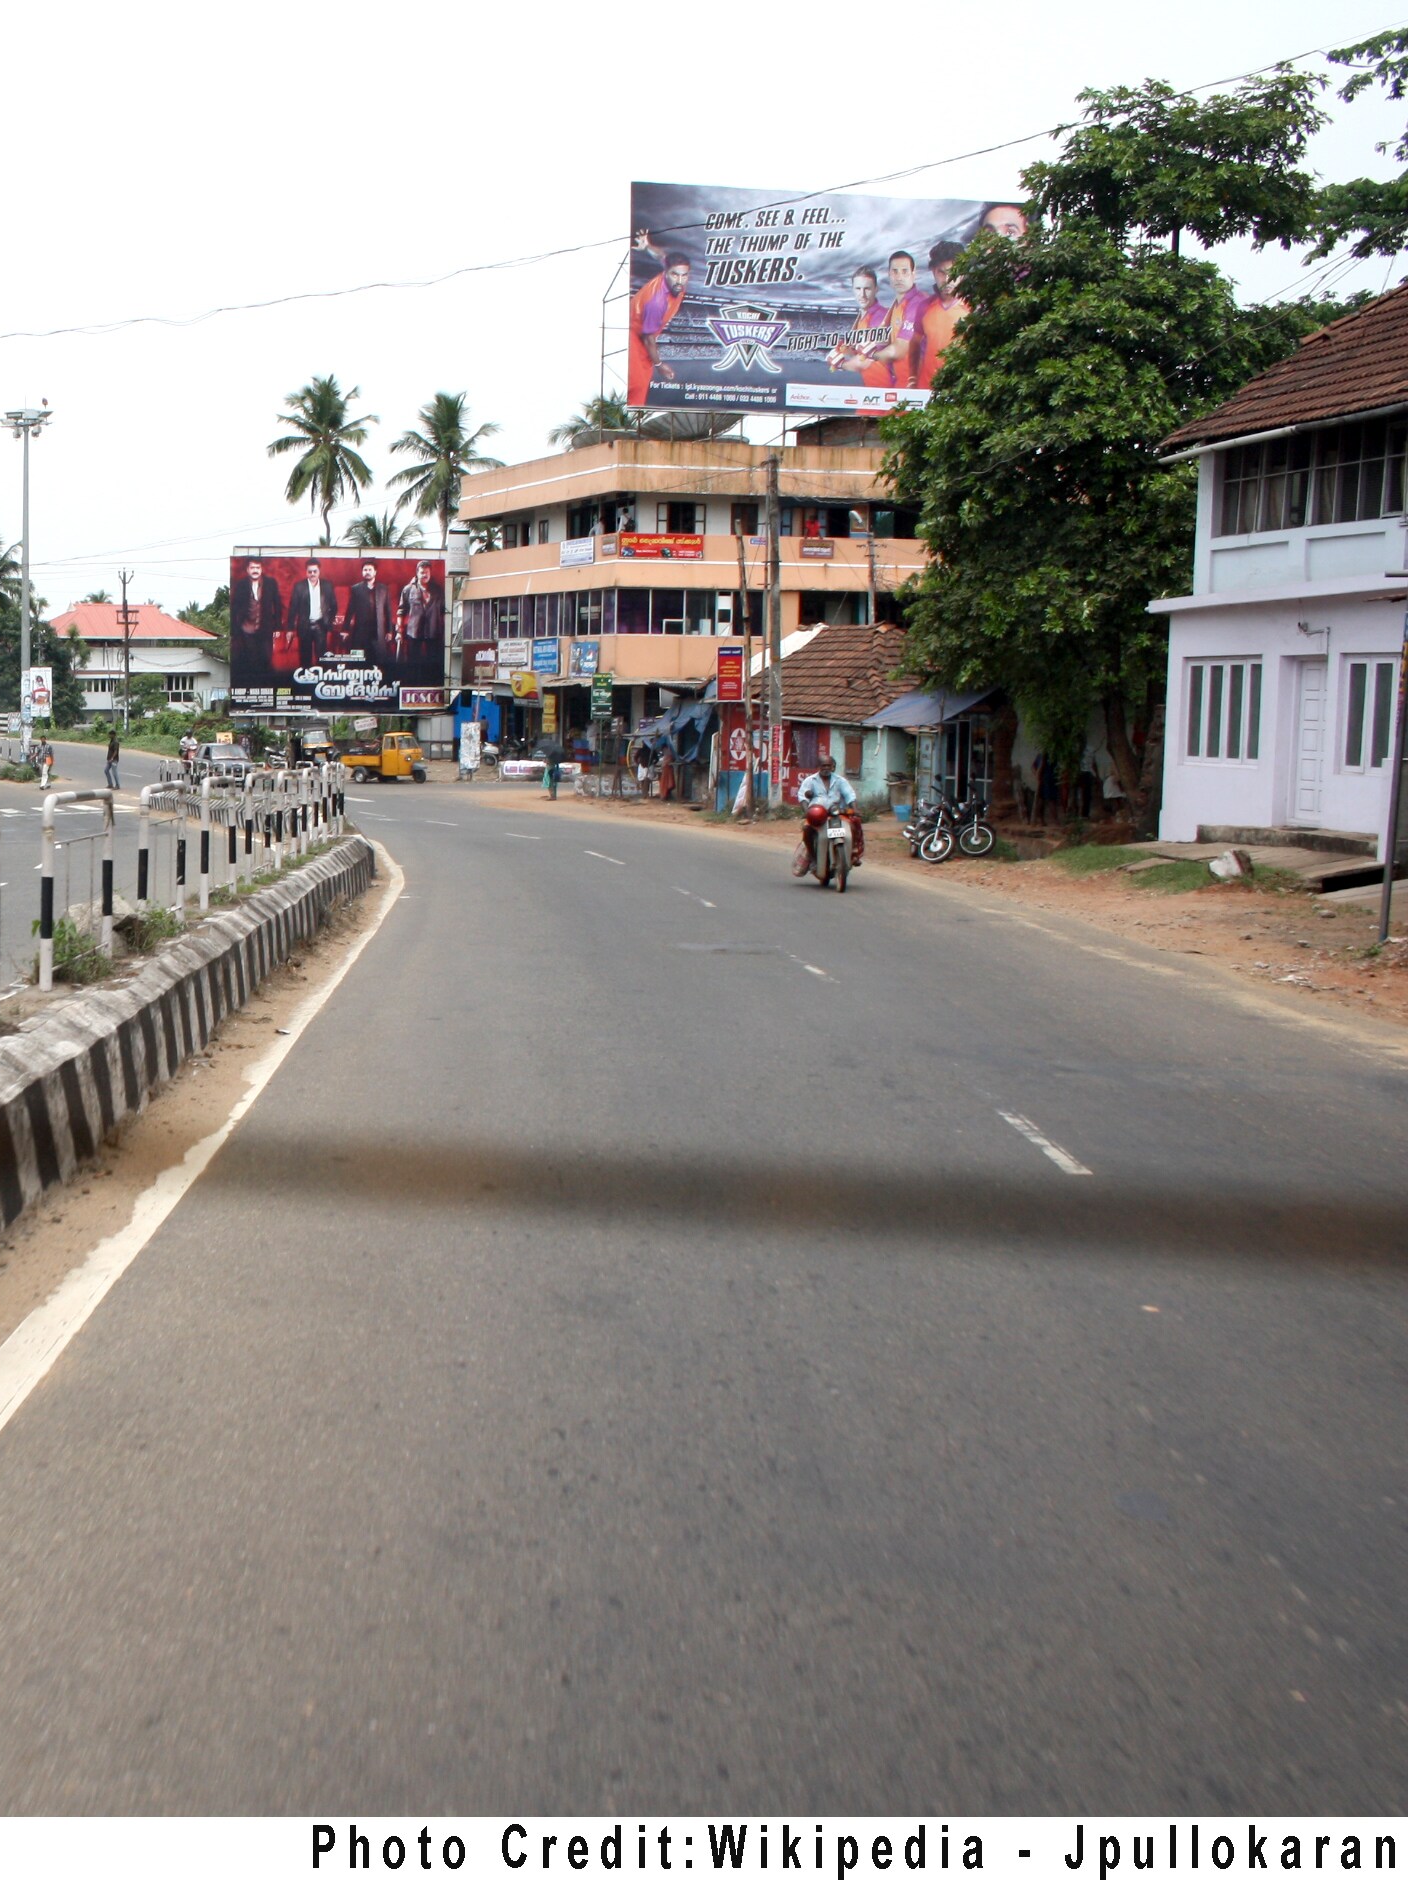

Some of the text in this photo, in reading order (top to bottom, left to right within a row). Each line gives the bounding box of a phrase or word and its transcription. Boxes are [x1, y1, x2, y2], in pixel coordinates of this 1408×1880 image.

[755, 210, 780, 228] SEE
[783, 209, 795, 226] &
[801, 207, 846, 225] FEEL...
[706, 231, 846, 255] THE THUMP OF THE
[704, 256, 804, 287] TUSKERS.
[736, 312, 761, 320] KOCHI
[720, 323, 776, 343] TUSKERS
[787, 326, 893, 351] FIGHT TO VICTORY
